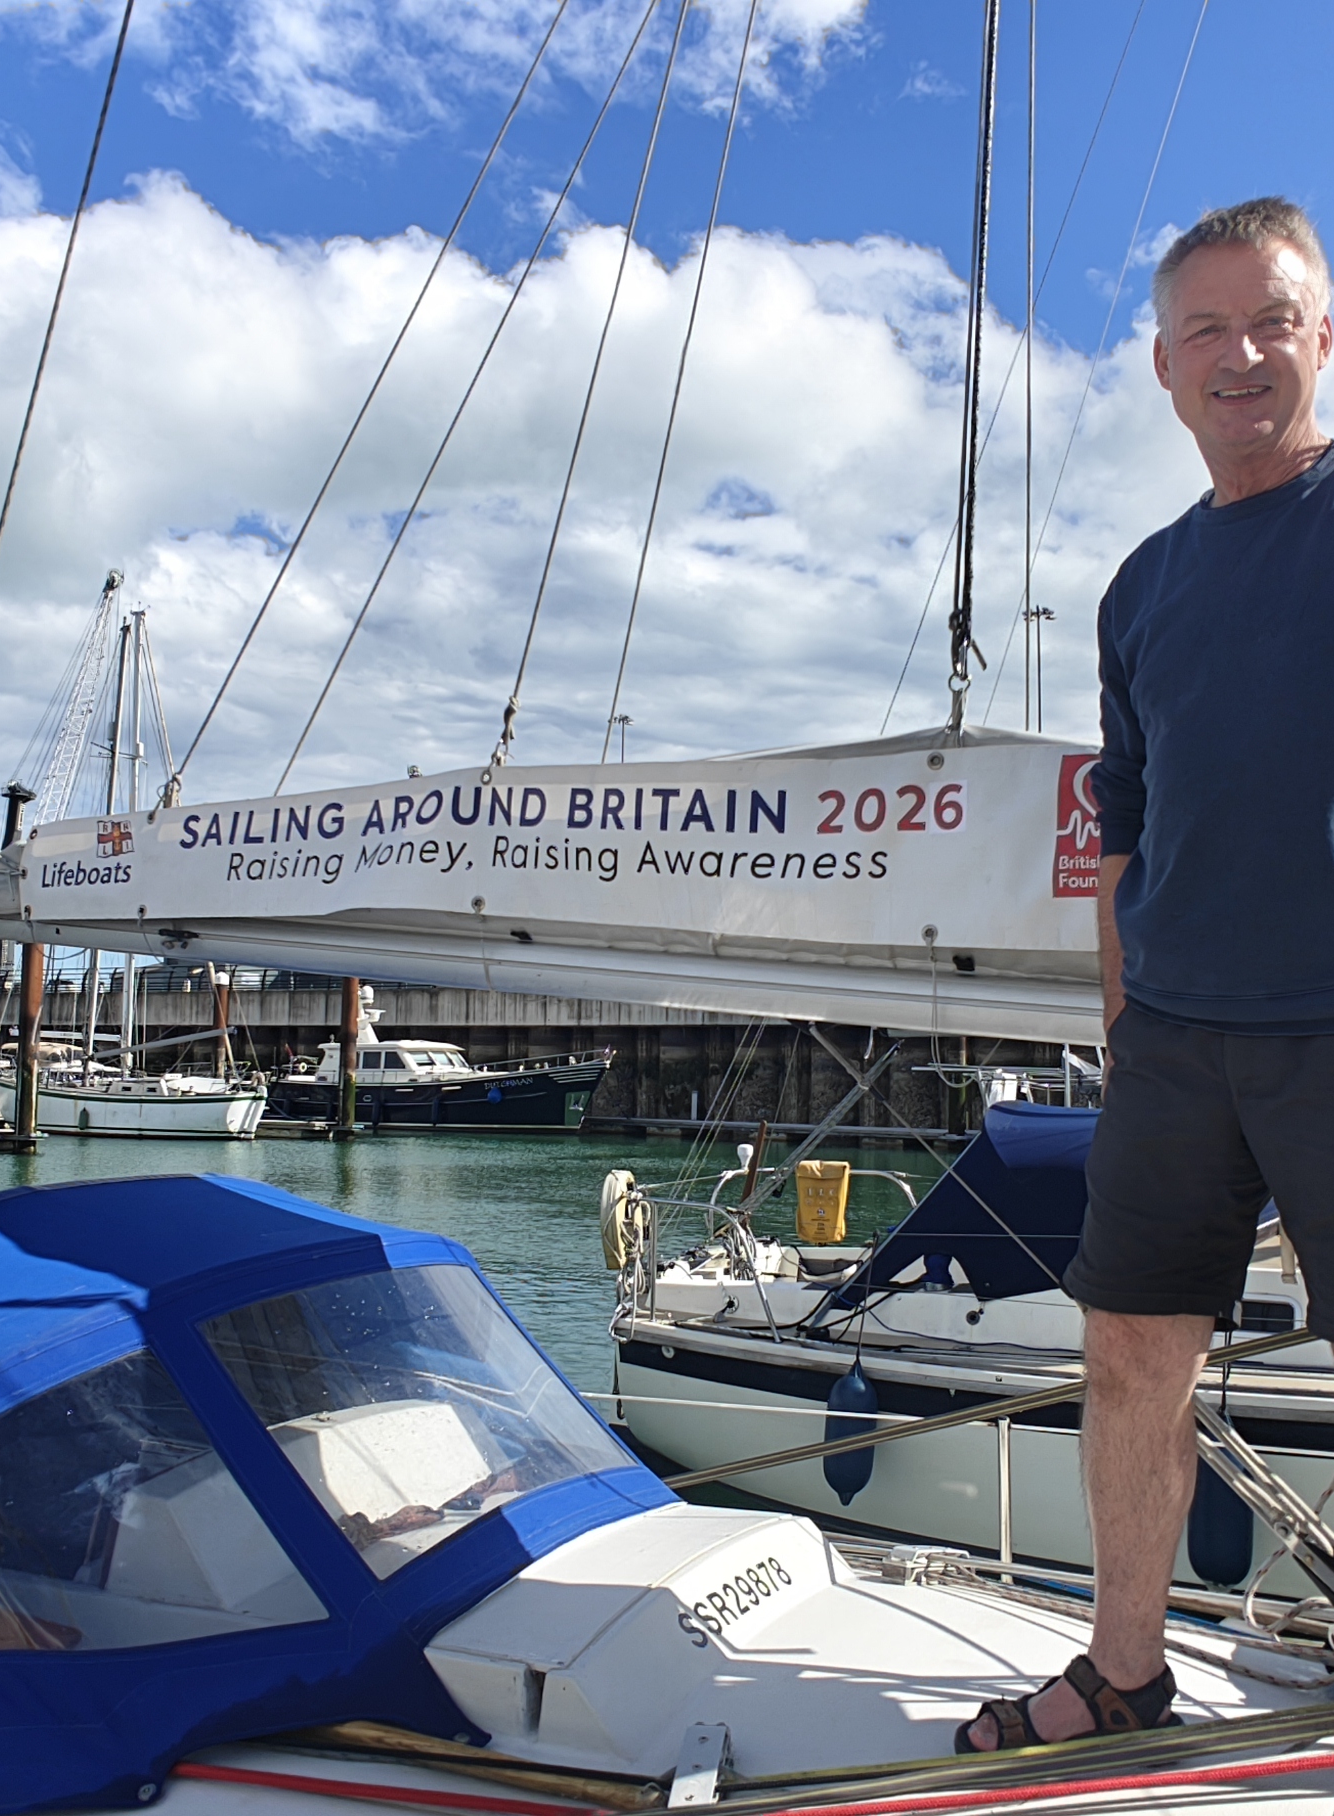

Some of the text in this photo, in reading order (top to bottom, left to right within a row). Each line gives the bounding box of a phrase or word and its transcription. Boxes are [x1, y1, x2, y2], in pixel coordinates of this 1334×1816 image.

[179, 783, 964, 849] SAILING AROUND BRITAIN 2026
[41, 860, 132, 889] Lifeboats
[226, 835, 889, 884] Raising Money, Raising Awareness
[484, 1077, 534, 1090] DUTCHMAN
[678, 1557, 792, 1648] SSR29878
